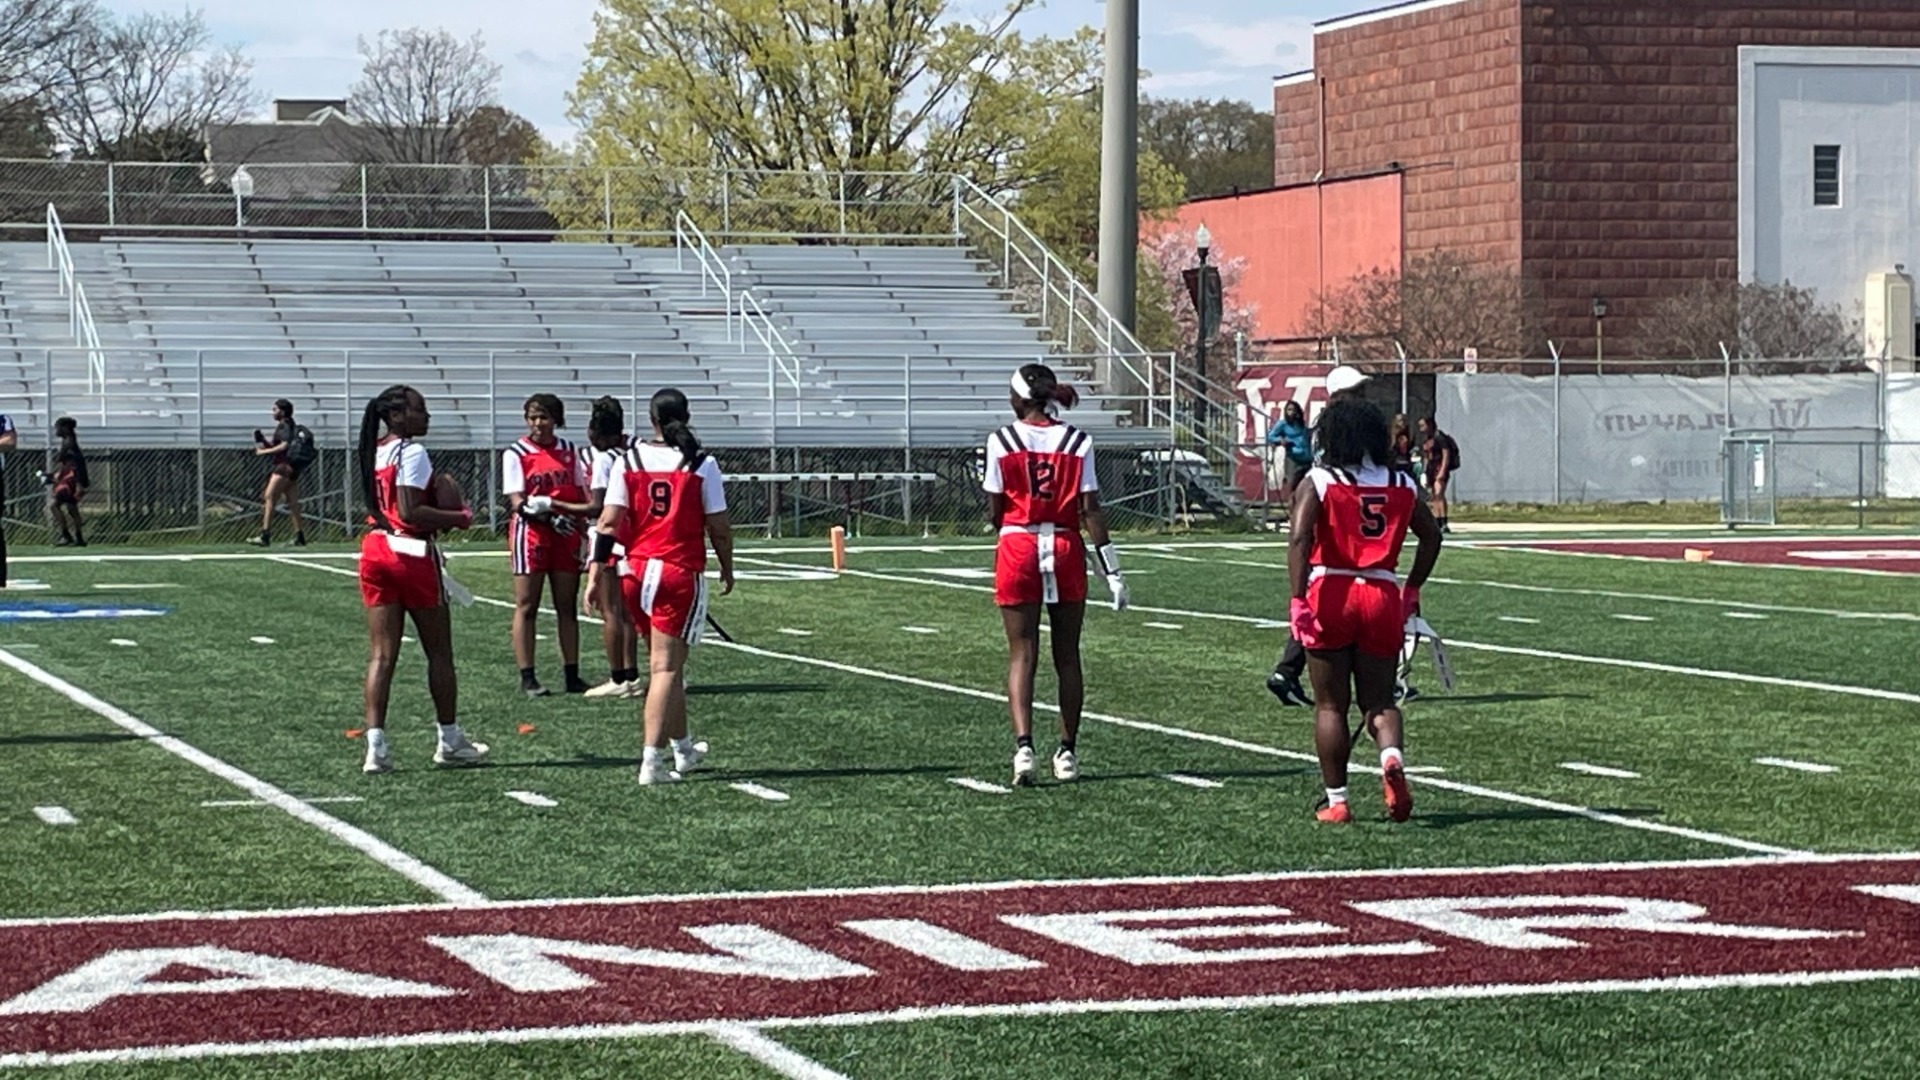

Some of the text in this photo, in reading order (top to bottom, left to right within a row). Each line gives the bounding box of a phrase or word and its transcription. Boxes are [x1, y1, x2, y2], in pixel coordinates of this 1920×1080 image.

[648, 480, 673, 519] 9
[1026, 459, 1057, 501] 12
[1359, 494, 1388, 539] 5
